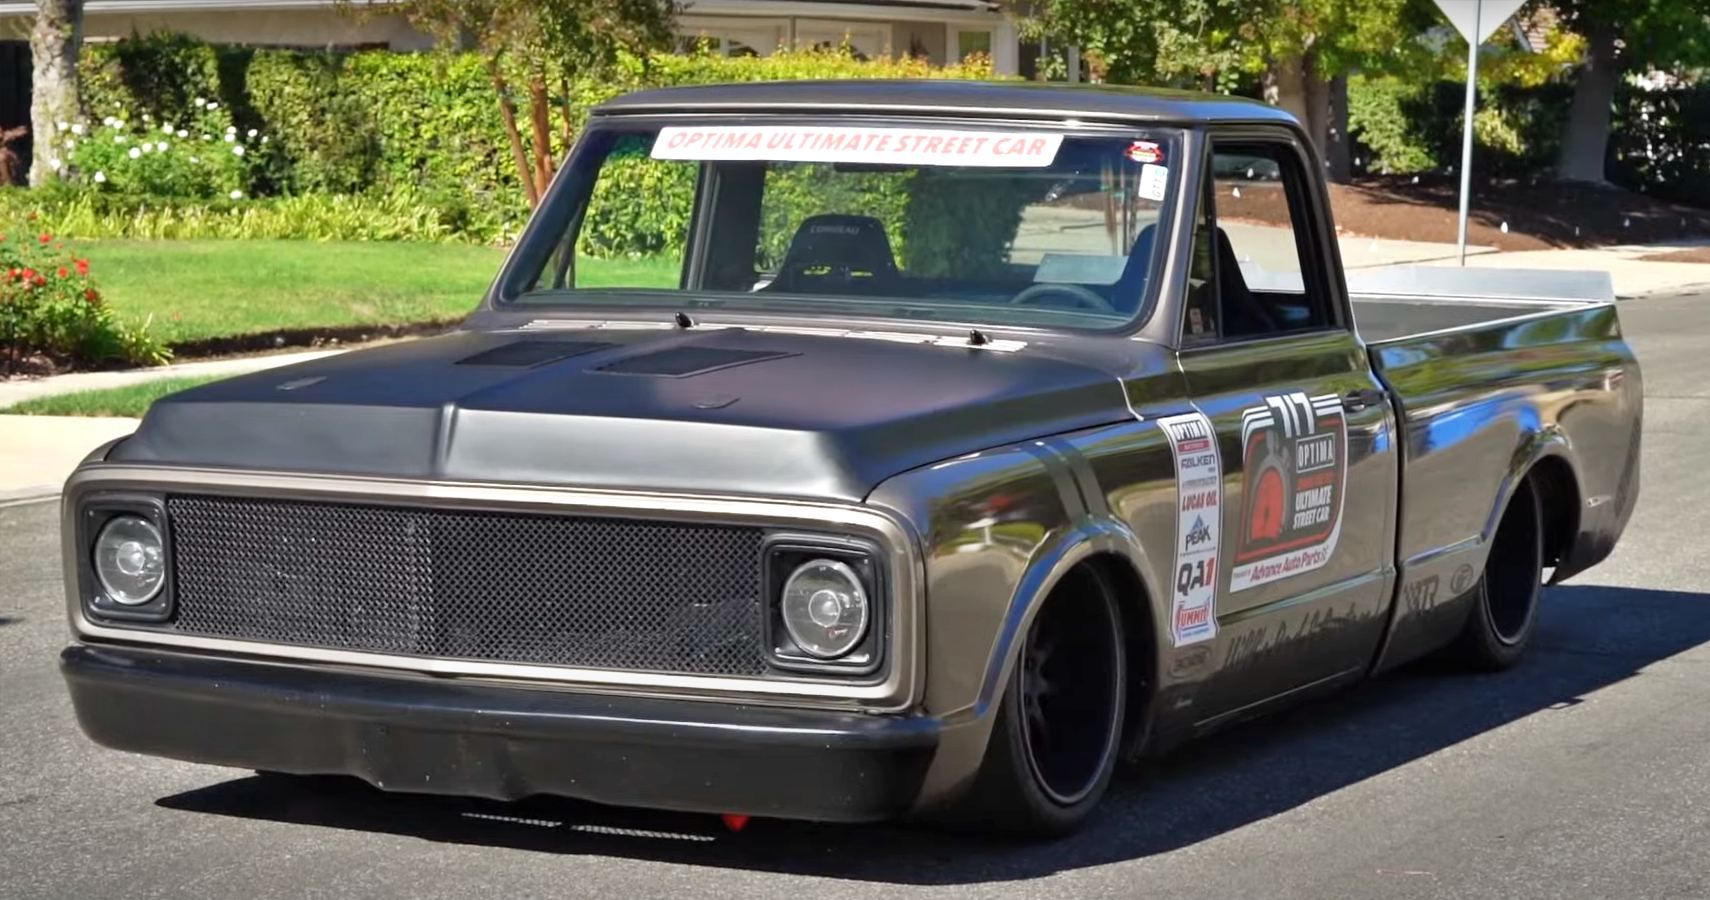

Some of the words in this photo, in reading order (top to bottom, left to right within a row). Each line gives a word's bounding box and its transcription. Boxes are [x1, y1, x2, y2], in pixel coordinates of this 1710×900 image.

[668, 132, 763, 150] OPTIMA
[766, 132, 892, 152] ULTIMATE
[893, 135, 990, 155] STREET
[991, 137, 1047, 156] CAR
[1170, 420, 1208, 441] OPTIMA
[1181, 453, 1217, 470] FALKEN
[1298, 439, 1334, 469] OPTIMA
[1182, 492, 1205, 512] LUCAS
[1205, 489, 1217, 508] OIL
[1295, 486, 1332, 512] ULTIMATE
[1292, 508, 1317, 530] STREET
[1316, 505, 1331, 522] CAR
[1184, 524, 1212, 552] PEAK
[1176, 557, 1216, 597] QA1
[1250, 564, 1282, 582] Advance
[1281, 556, 1302, 573] Auto
[1301, 550, 1321, 568] Parts
